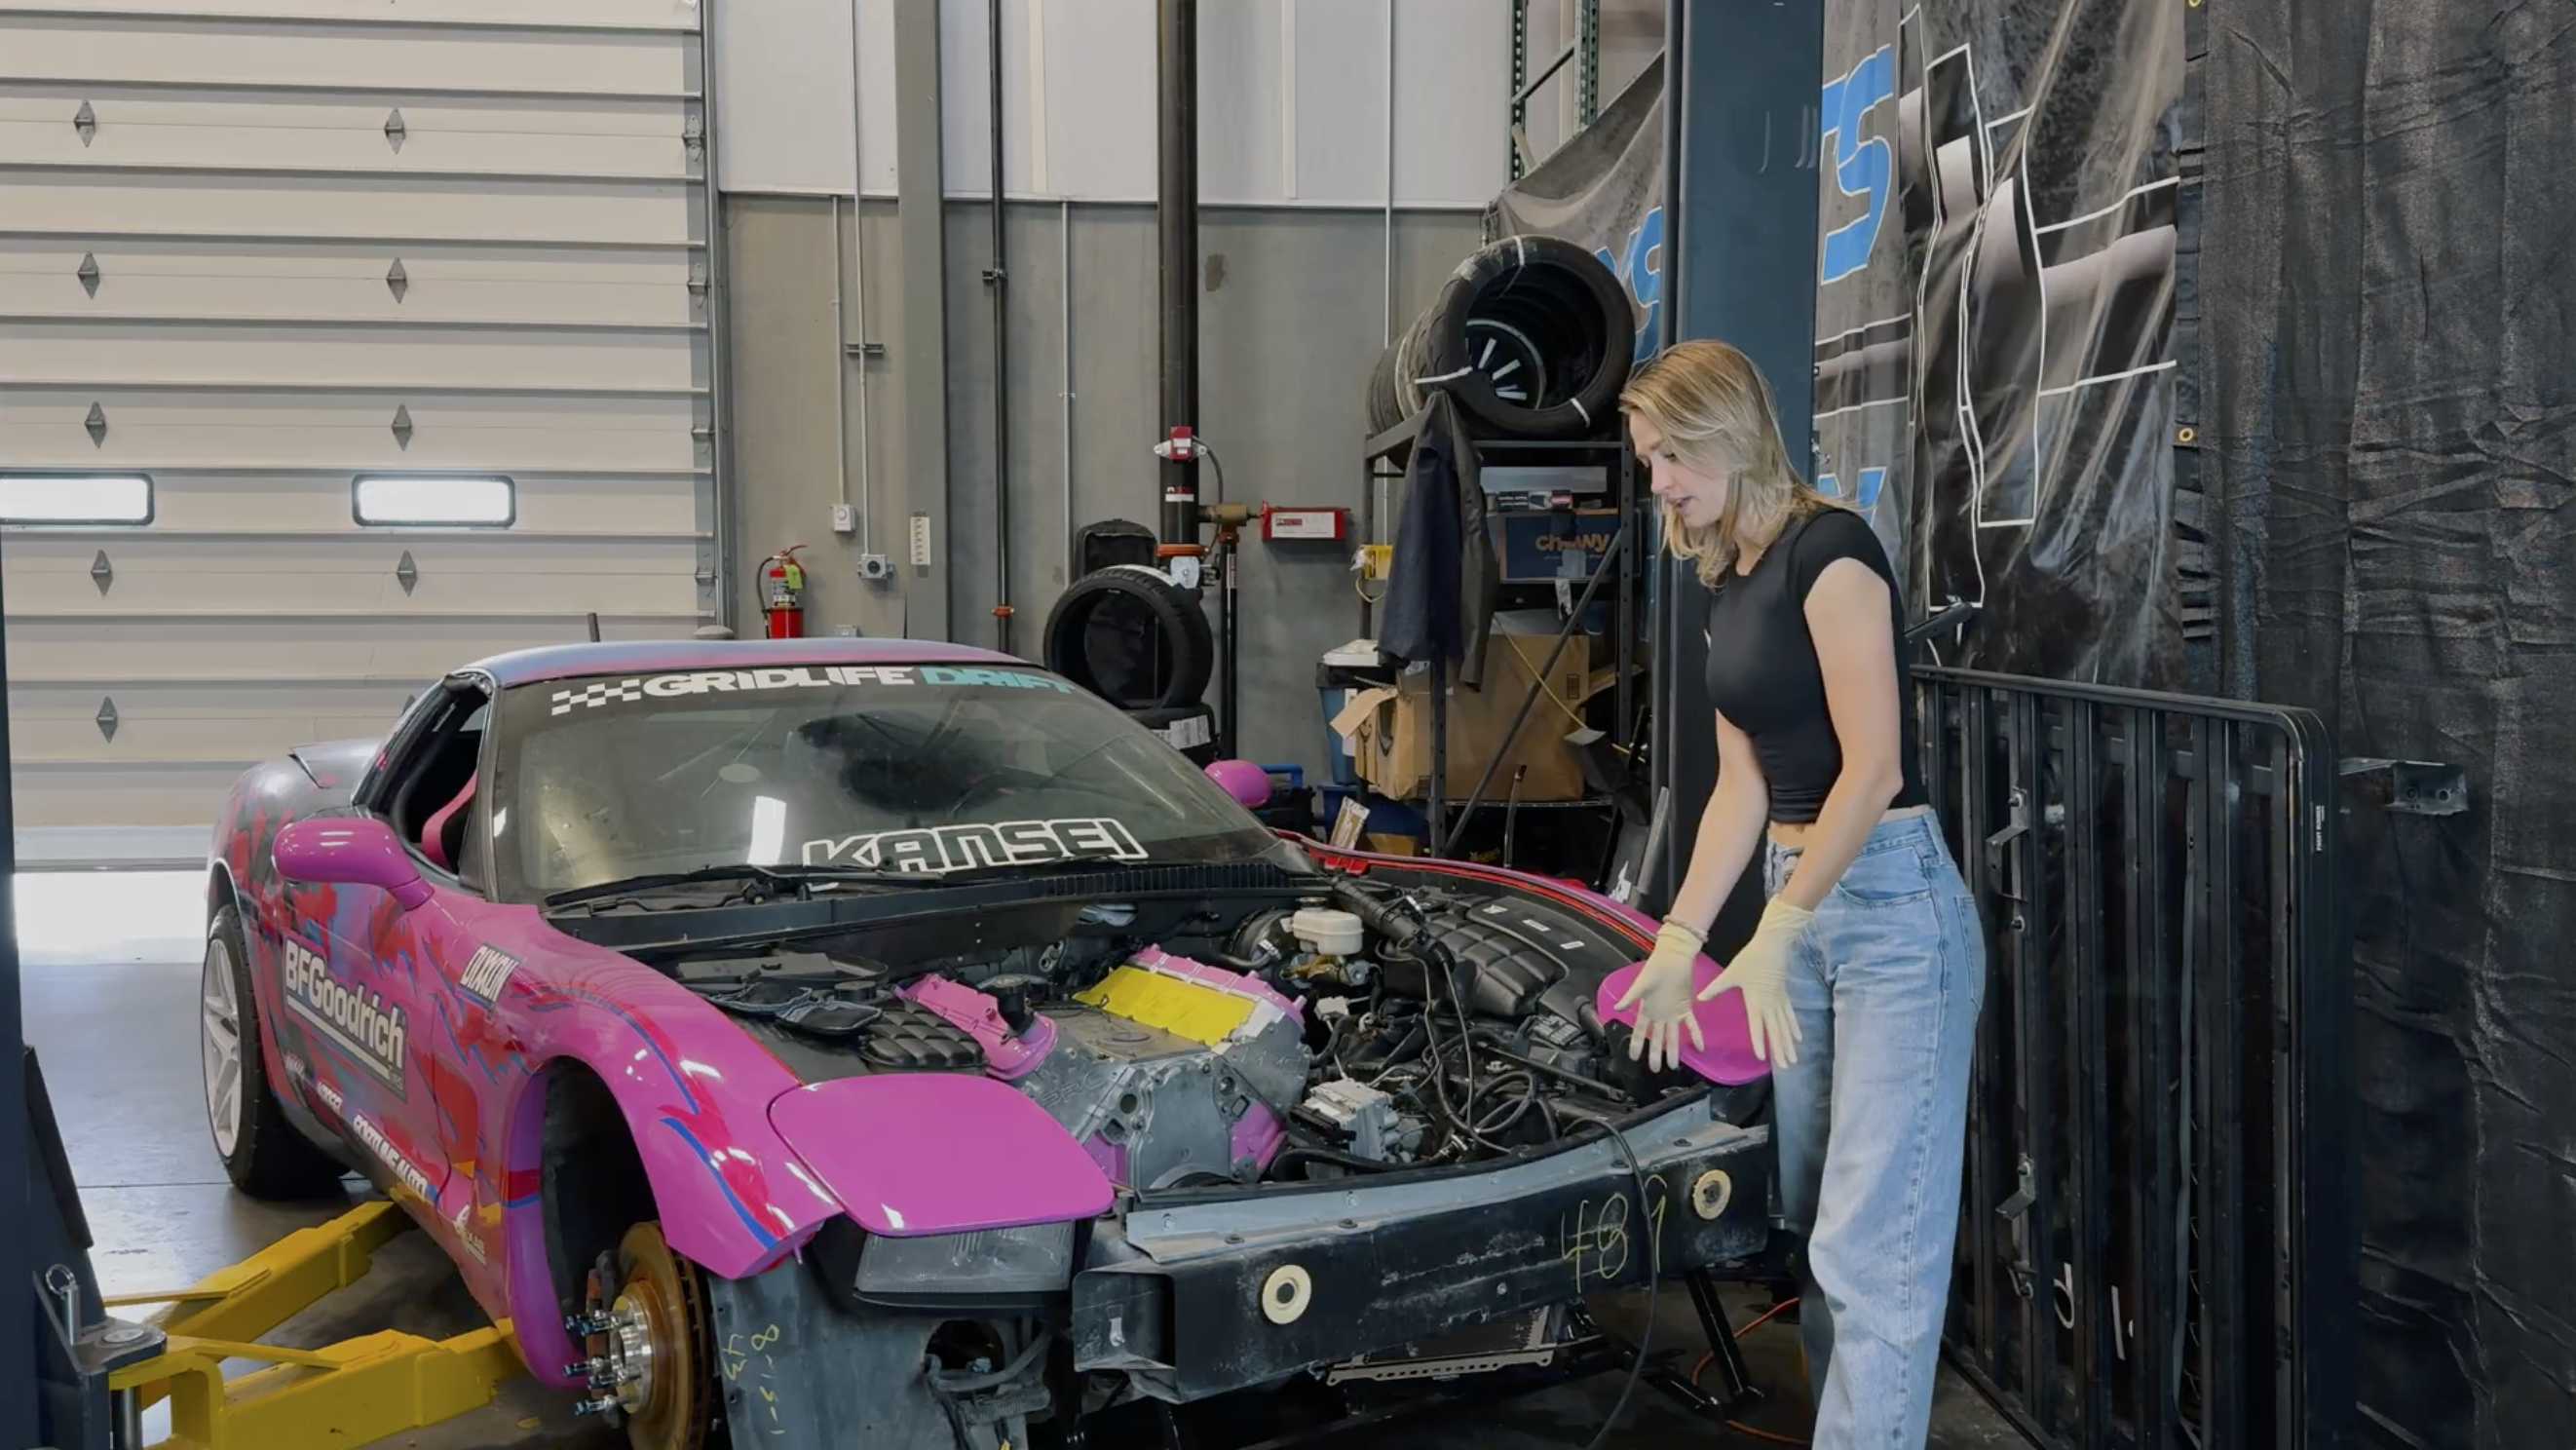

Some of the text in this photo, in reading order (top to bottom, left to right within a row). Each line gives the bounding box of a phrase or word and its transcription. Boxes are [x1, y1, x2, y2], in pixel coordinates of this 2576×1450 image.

[642, 666, 1075, 698] GRIDLIFE DRIFT
[803, 818, 1150, 874] KANSEI
[285, 939, 404, 1069] BFGoodrich
